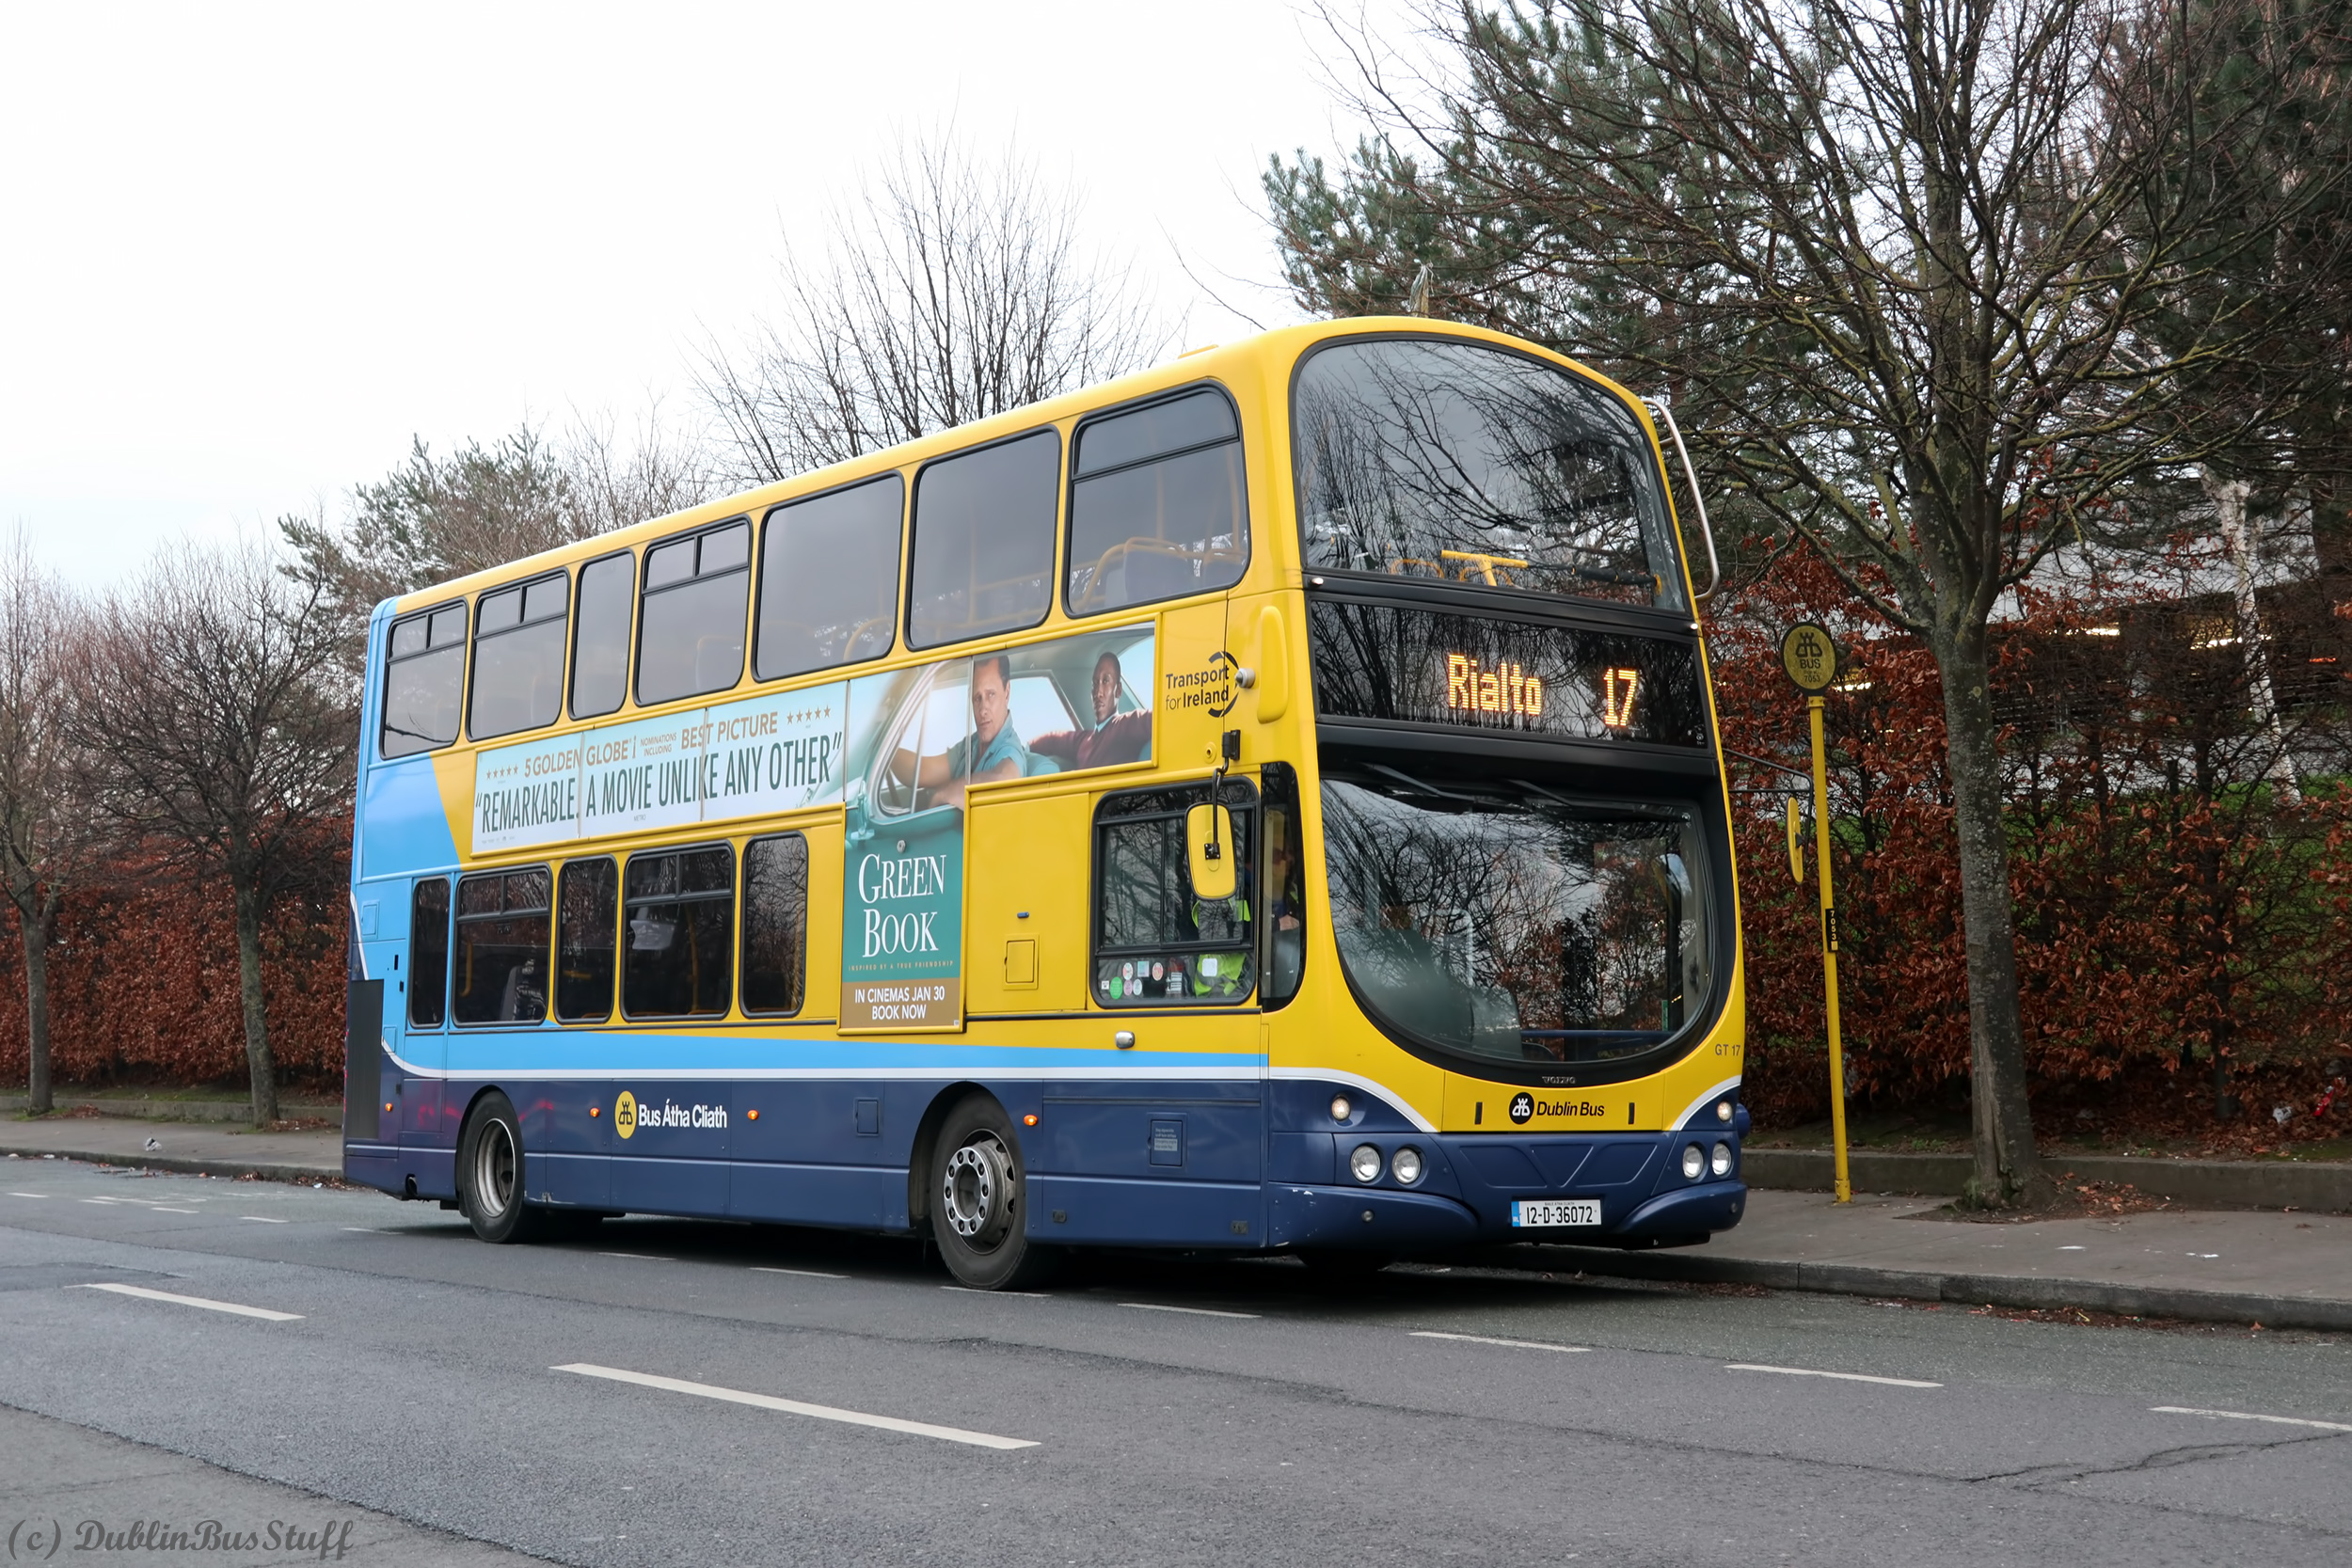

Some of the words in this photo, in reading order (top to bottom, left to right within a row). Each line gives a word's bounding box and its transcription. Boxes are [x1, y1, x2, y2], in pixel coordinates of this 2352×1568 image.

[1800, 658, 1821, 669] BUS
[1166, 664, 1230, 689] Transport
[1804, 674, 1821, 683] 7053
[1166, 694, 1182, 710] for
[1183, 685, 1230, 708] Ireland
[1448, 653, 1542, 716] Rialto
[1603, 668, 1638, 726] 17
[640, 733, 677, 747] NOMINATIONS
[681, 722, 714, 750] BEST
[718, 711, 778, 743] PICTURE
[644, 744, 673, 756] INCLUDING
[524, 757, 532, 778] 5
[532, 748, 581, 777] GOLDEN
[586, 774, 596, 817] A
[602, 765, 653, 816] MOVIE
[659, 752, 719, 807] UNLIKE
[724, 745, 763, 797] ANY
[858, 853, 946, 904] GREEN
[862, 908, 939, 958] BOOK
[849, 963, 878, 972] INSPIRED
[897, 961, 912, 970] TRUE
[914, 959, 954, 969] FRIENDSHIP
[854, 989, 866, 1004] IN
[867, 987, 910, 1004] CINEMAS
[912, 986, 931, 1002] JAN
[933, 985, 946, 1001] 30
[871, 1005, 899, 1021] BOOK
[901, 1004, 927, 1020] NOW
[1715, 1043, 1729, 1056] GT
[1732, 1044, 1741, 1056] 17
[1542, 1076, 1577, 1085] VOLVO
[638, 1103, 661, 1127] Bus
[661, 1099, 691, 1128] Átha
[691, 1104, 727, 1129] Cliath
[1536, 1101, 1578, 1117] Dublin
[1580, 1101, 1605, 1117] Bus
[1526, 1206, 1593, 1225] 12-D-36072
